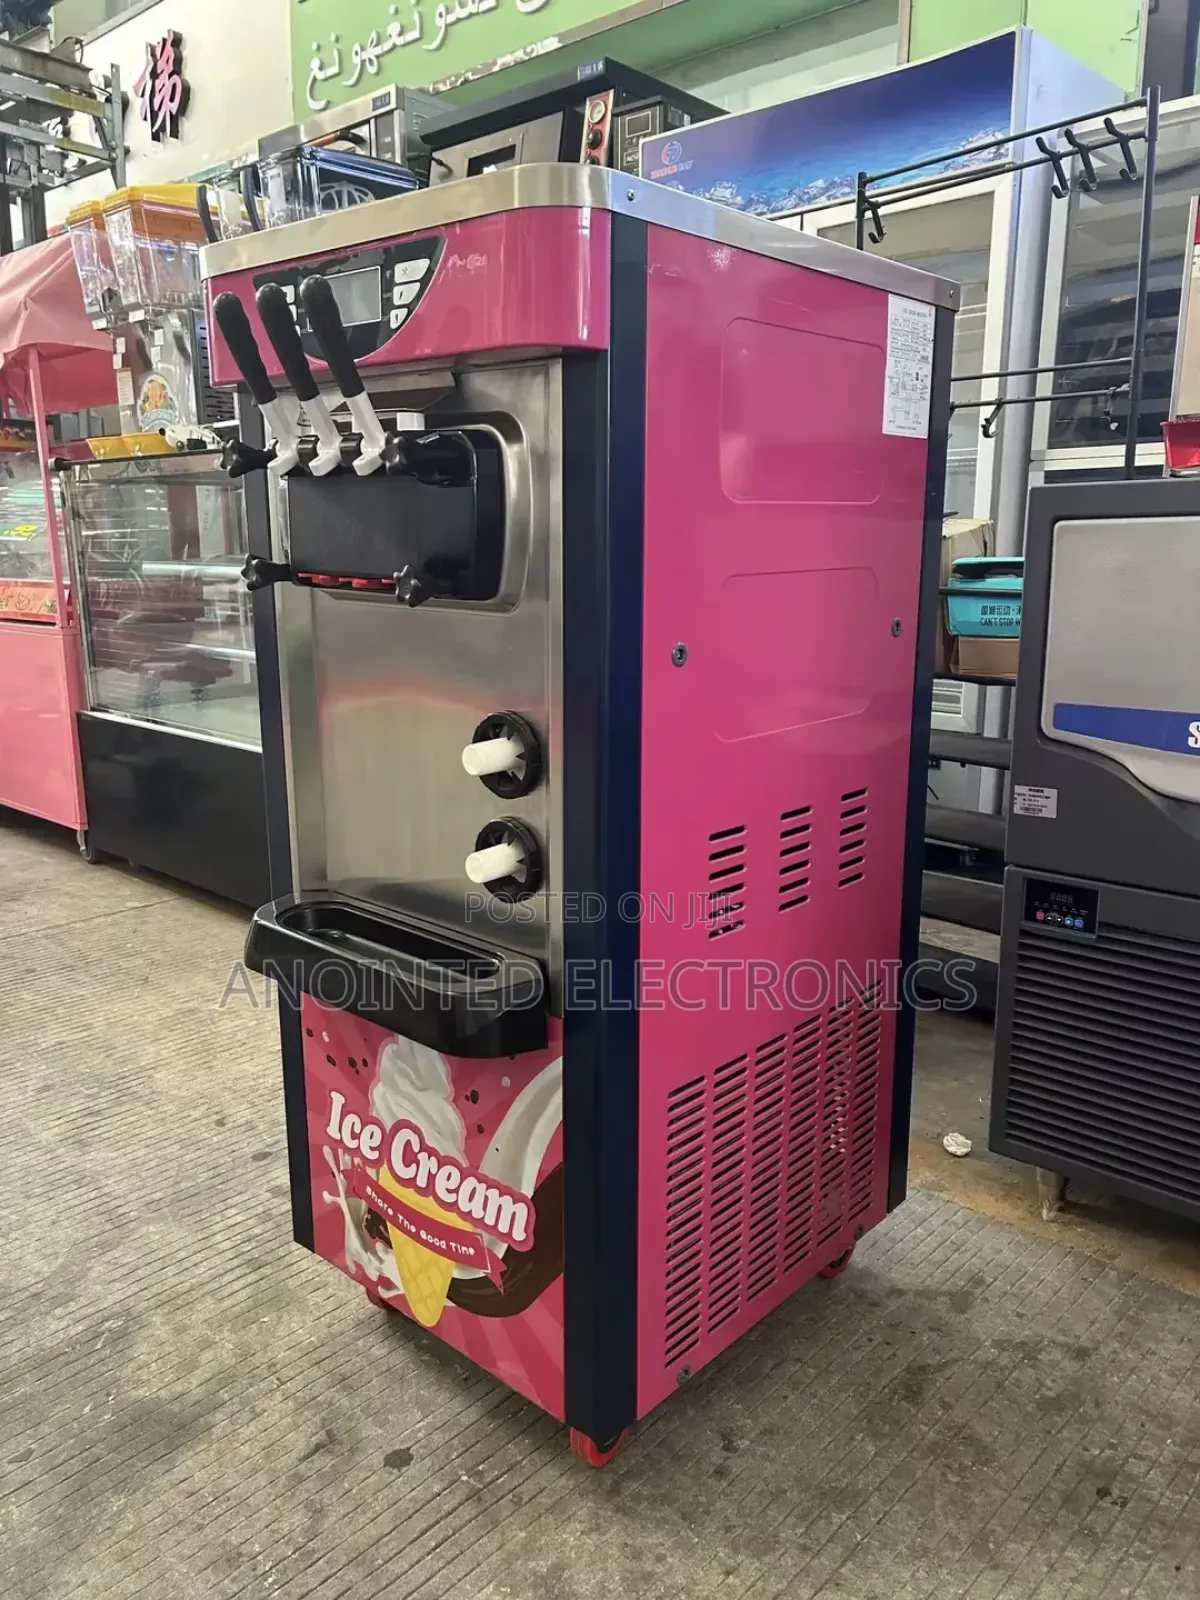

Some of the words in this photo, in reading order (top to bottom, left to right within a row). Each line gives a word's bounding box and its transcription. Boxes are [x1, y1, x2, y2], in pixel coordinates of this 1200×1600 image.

[326, 1090, 382, 1160] Ice
[390, 1128, 529, 1241] Cream
[396, 1213, 417, 1233] The
[419, 1229, 447, 1250] Good
